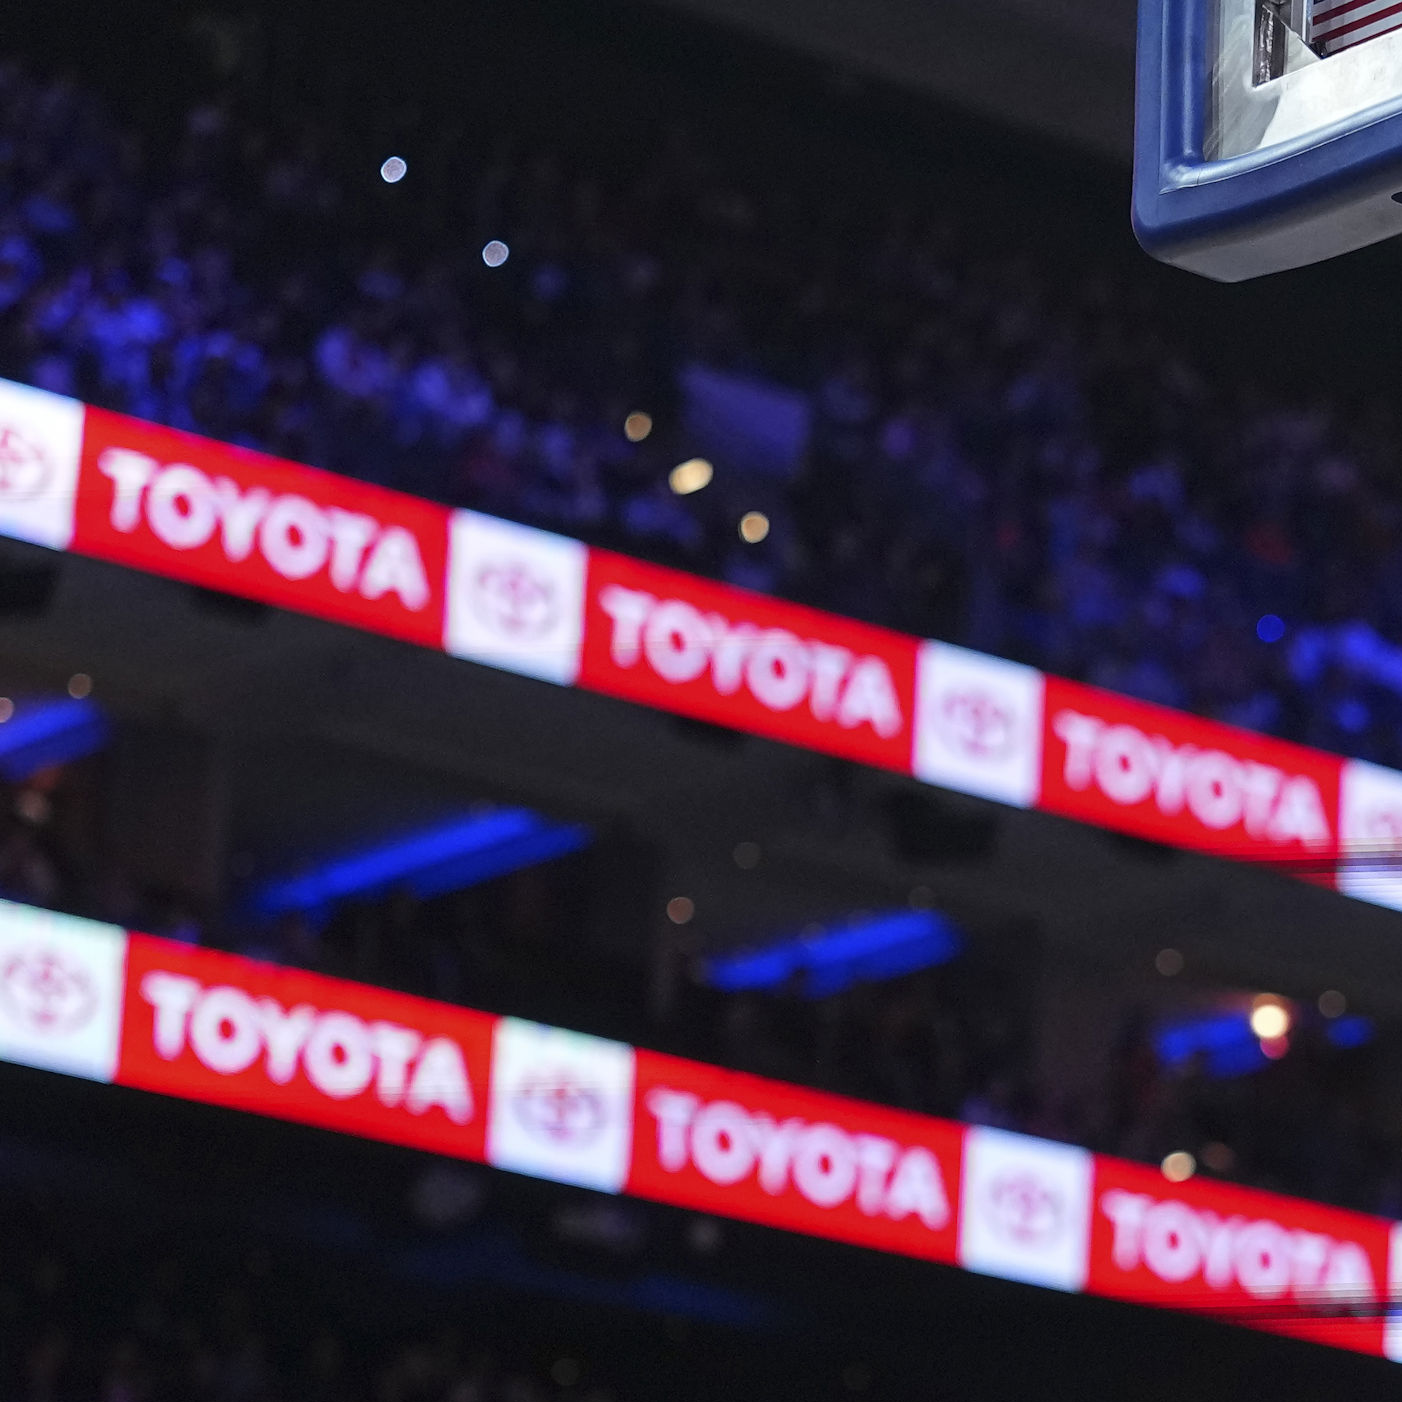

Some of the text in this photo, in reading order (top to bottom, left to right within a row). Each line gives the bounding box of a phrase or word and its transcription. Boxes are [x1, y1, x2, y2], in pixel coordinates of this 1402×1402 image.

[98, 444, 432, 612] TOYOTA
[600, 584, 902, 739] TOYOTA
[1052, 708, 1331, 848] TOYOTA
[142, 969, 473, 1125] TOYOTA
[646, 1087, 950, 1229] TOYOTA
[1102, 1188, 1378, 1312] TOYOTA
